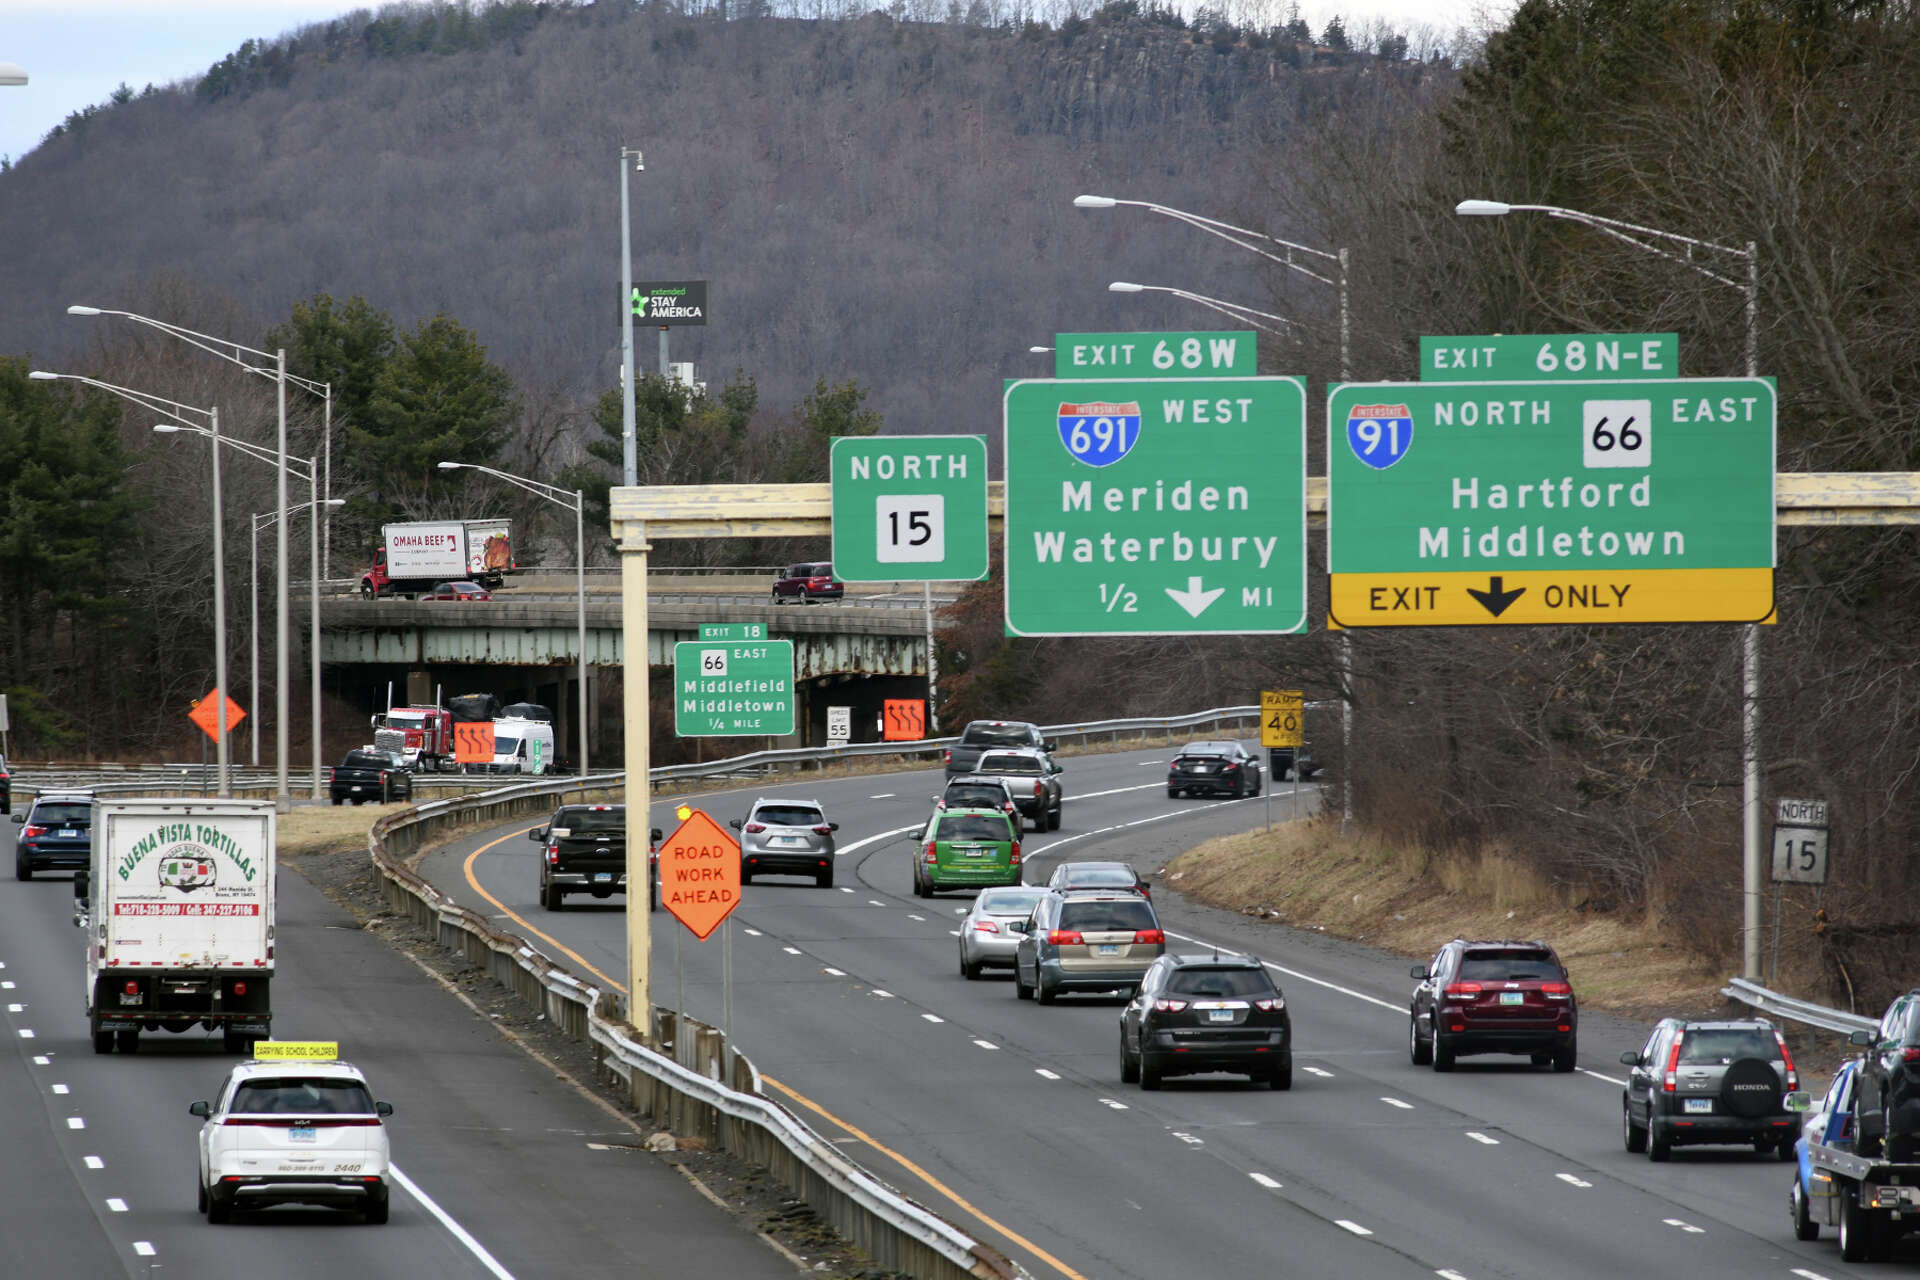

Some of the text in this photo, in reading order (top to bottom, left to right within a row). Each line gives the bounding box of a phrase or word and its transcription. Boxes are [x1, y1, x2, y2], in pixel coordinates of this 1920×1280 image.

[650, 288, 686, 296] extended
[651, 296, 677, 307] STAY
[651, 307, 702, 318] AMERICA
[1073, 338, 1237, 370] EXIT 68W
[1434, 340, 1664, 372] EXIT 68N-E
[1357, 407, 1402, 417] INTERSTATE
[1071, 399, 1253, 455] 691 WEST
[1357, 397, 1757, 456] 91 NORTH 66 EAST
[851, 454, 968, 480] NORTH
[1063, 480, 1249, 512] Meriden
[1452, 475, 1651, 509] Hartford
[888, 511, 932, 546] 15
[393, 535, 445, 547] OMAHA BEEF
[1419, 525, 1686, 558] Middletown
[1034, 531, 1278, 569] Waterbury
[1242, 587, 1274, 608] MI
[1370, 584, 1633, 611] EXIT ONLY
[705, 626, 761, 638] EXIT 18
[704, 648, 767, 670] 66 EAST
[684, 680, 785, 693] Middlefield
[683, 700, 785, 713] Middletown
[734, 719, 761, 728] MILE
[831, 724, 847, 736] 55
[1268, 715, 1297, 731] 40
[1781, 804, 1824, 820] NORTH
[118, 823, 257, 882] BUENA VISTA TORTILLAS
[674, 846, 724, 860] ROAD
[1786, 839, 1816, 871] 15
[676, 868, 724, 882] WORK
[671, 889, 732, 903] AHEAD
[255, 1046, 337, 1057] CARRYING SCHOOL CHILDREN
[333, 1164, 361, 1173] 2440
